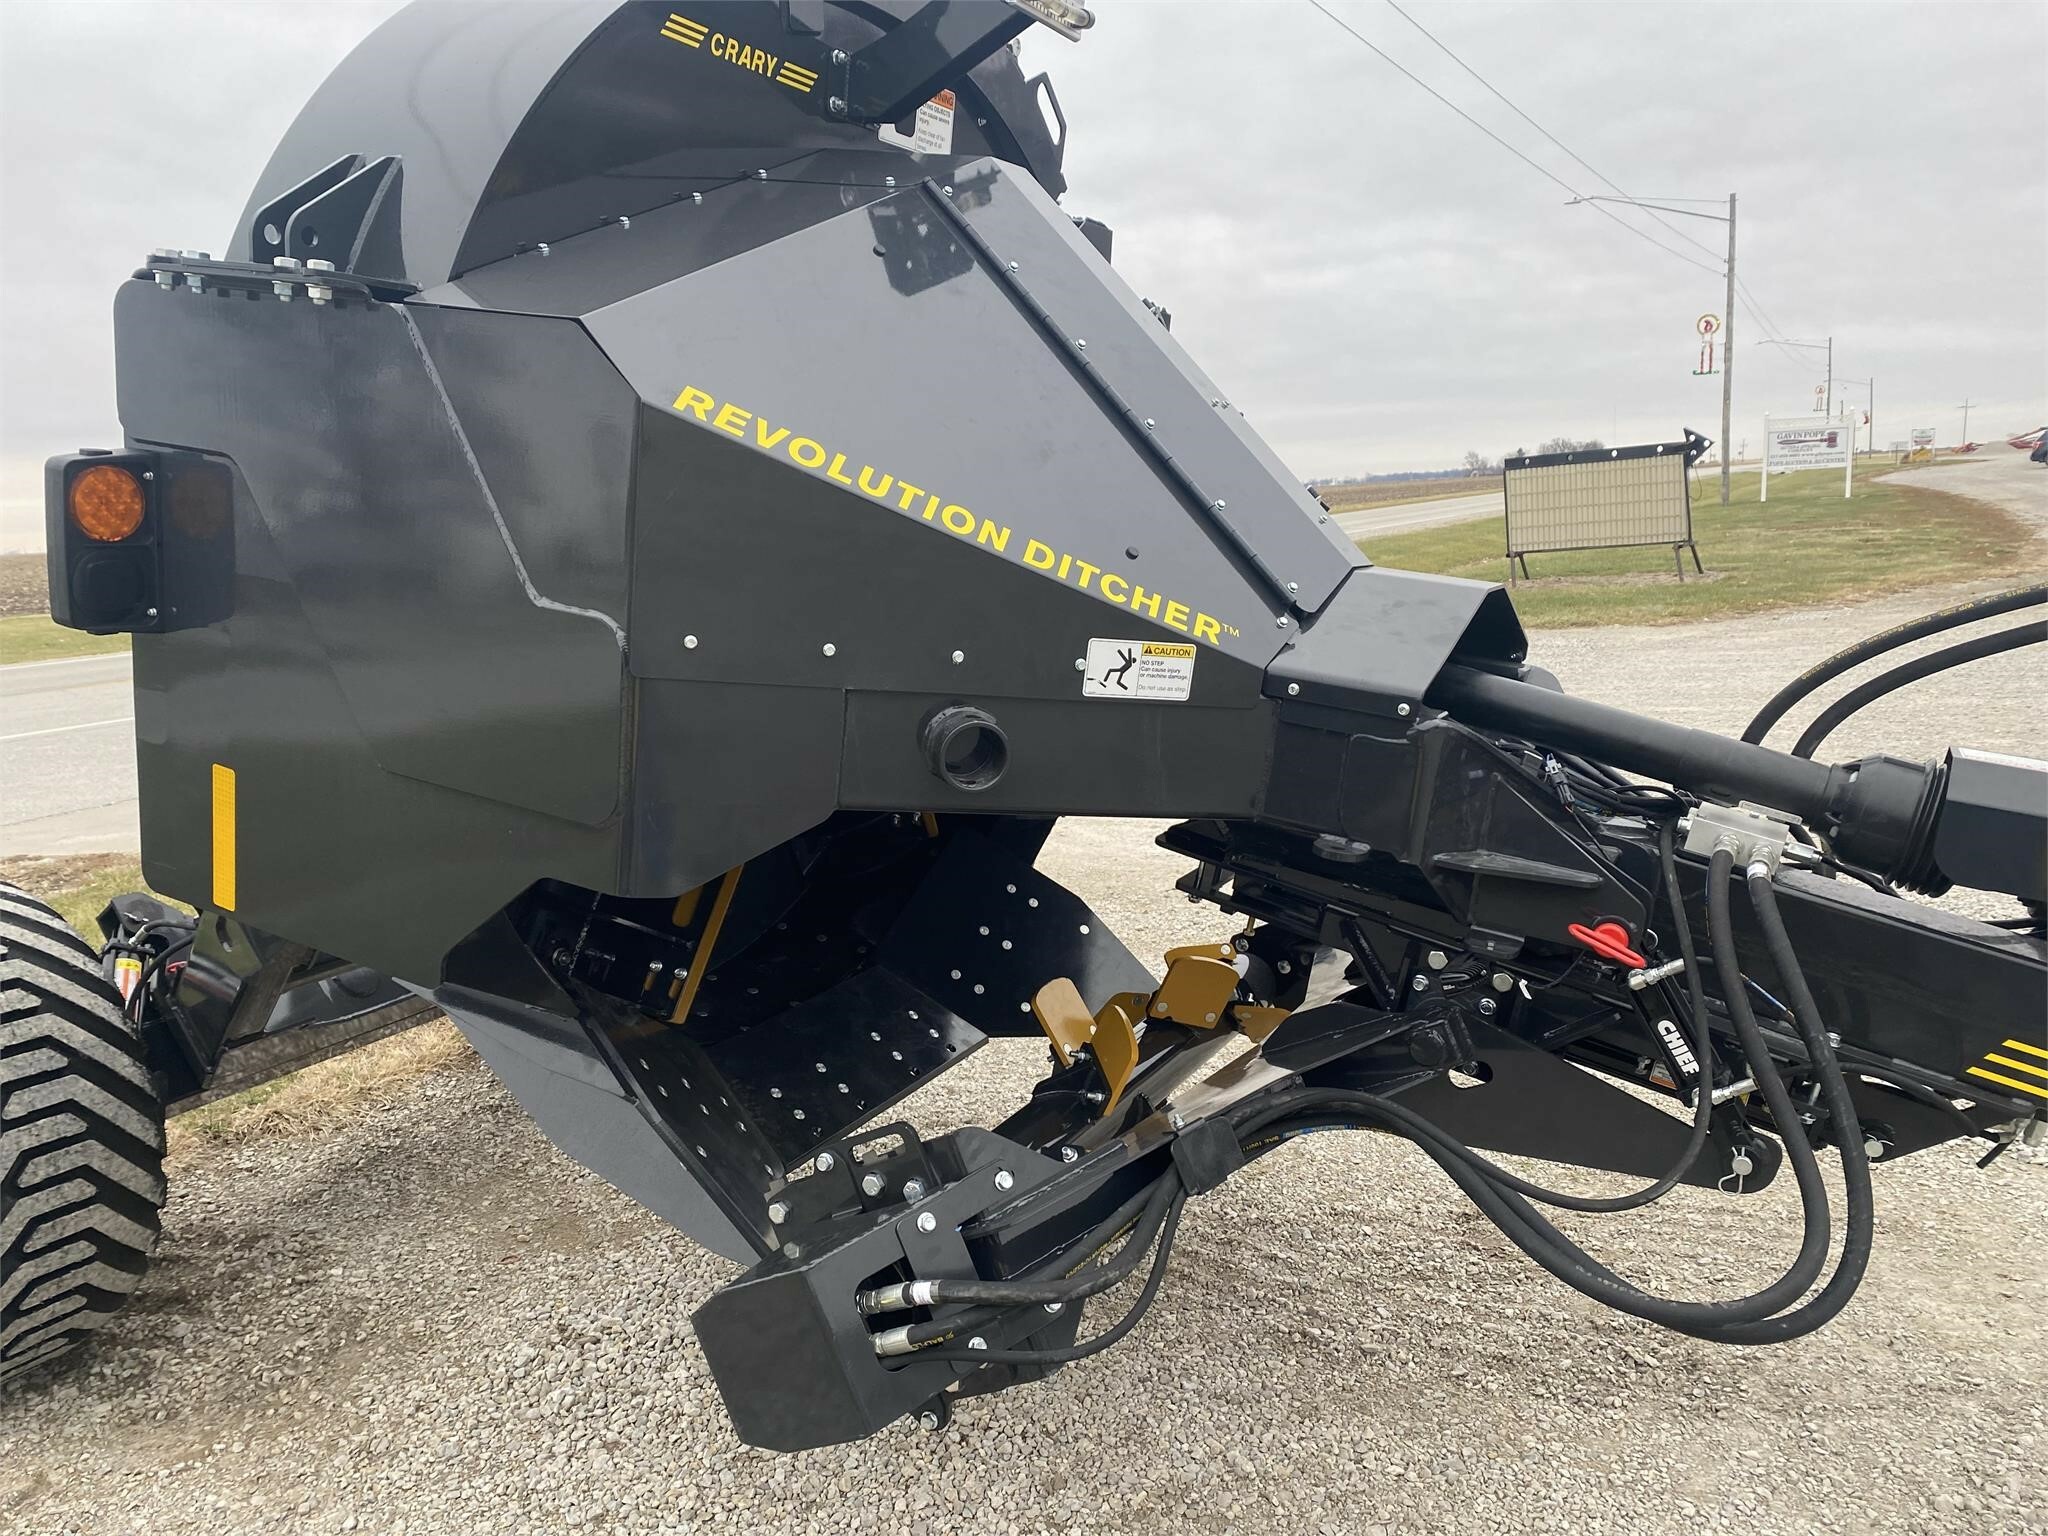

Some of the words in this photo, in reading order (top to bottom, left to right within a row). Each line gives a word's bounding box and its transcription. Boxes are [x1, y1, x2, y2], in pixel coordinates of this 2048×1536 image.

[710, 32, 778, 78] CRARY
[672, 385, 1012, 553] REVOLUTION
[1022, 538, 1220, 646] DITCHER
[1153, 647, 1191, 657] CAUTION
[1657, 1019, 1701, 1077] CHIEF
